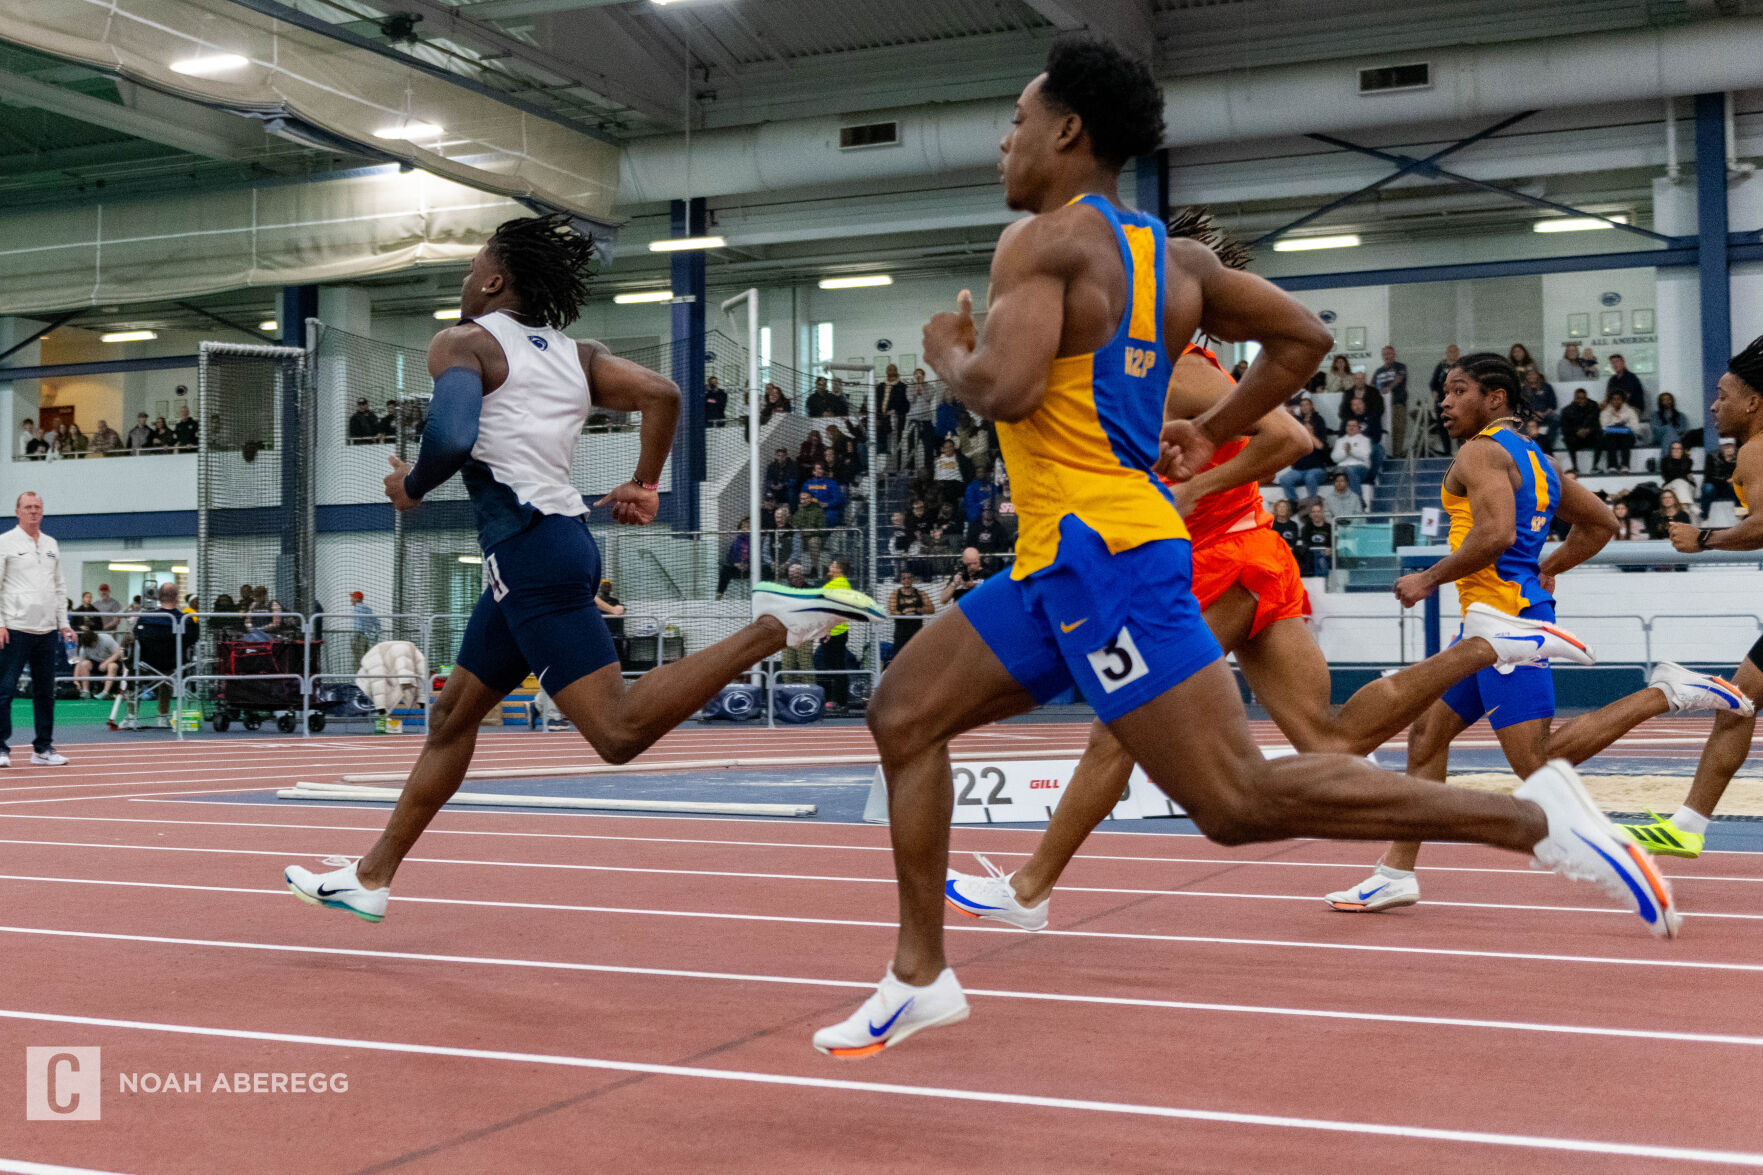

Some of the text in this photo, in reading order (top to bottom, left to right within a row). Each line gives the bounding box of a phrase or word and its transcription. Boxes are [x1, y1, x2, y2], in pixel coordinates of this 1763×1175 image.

[1102, 637, 1133, 681] 3
[952, 766, 1013, 805] 22
[1029, 779, 1060, 790] GILL
